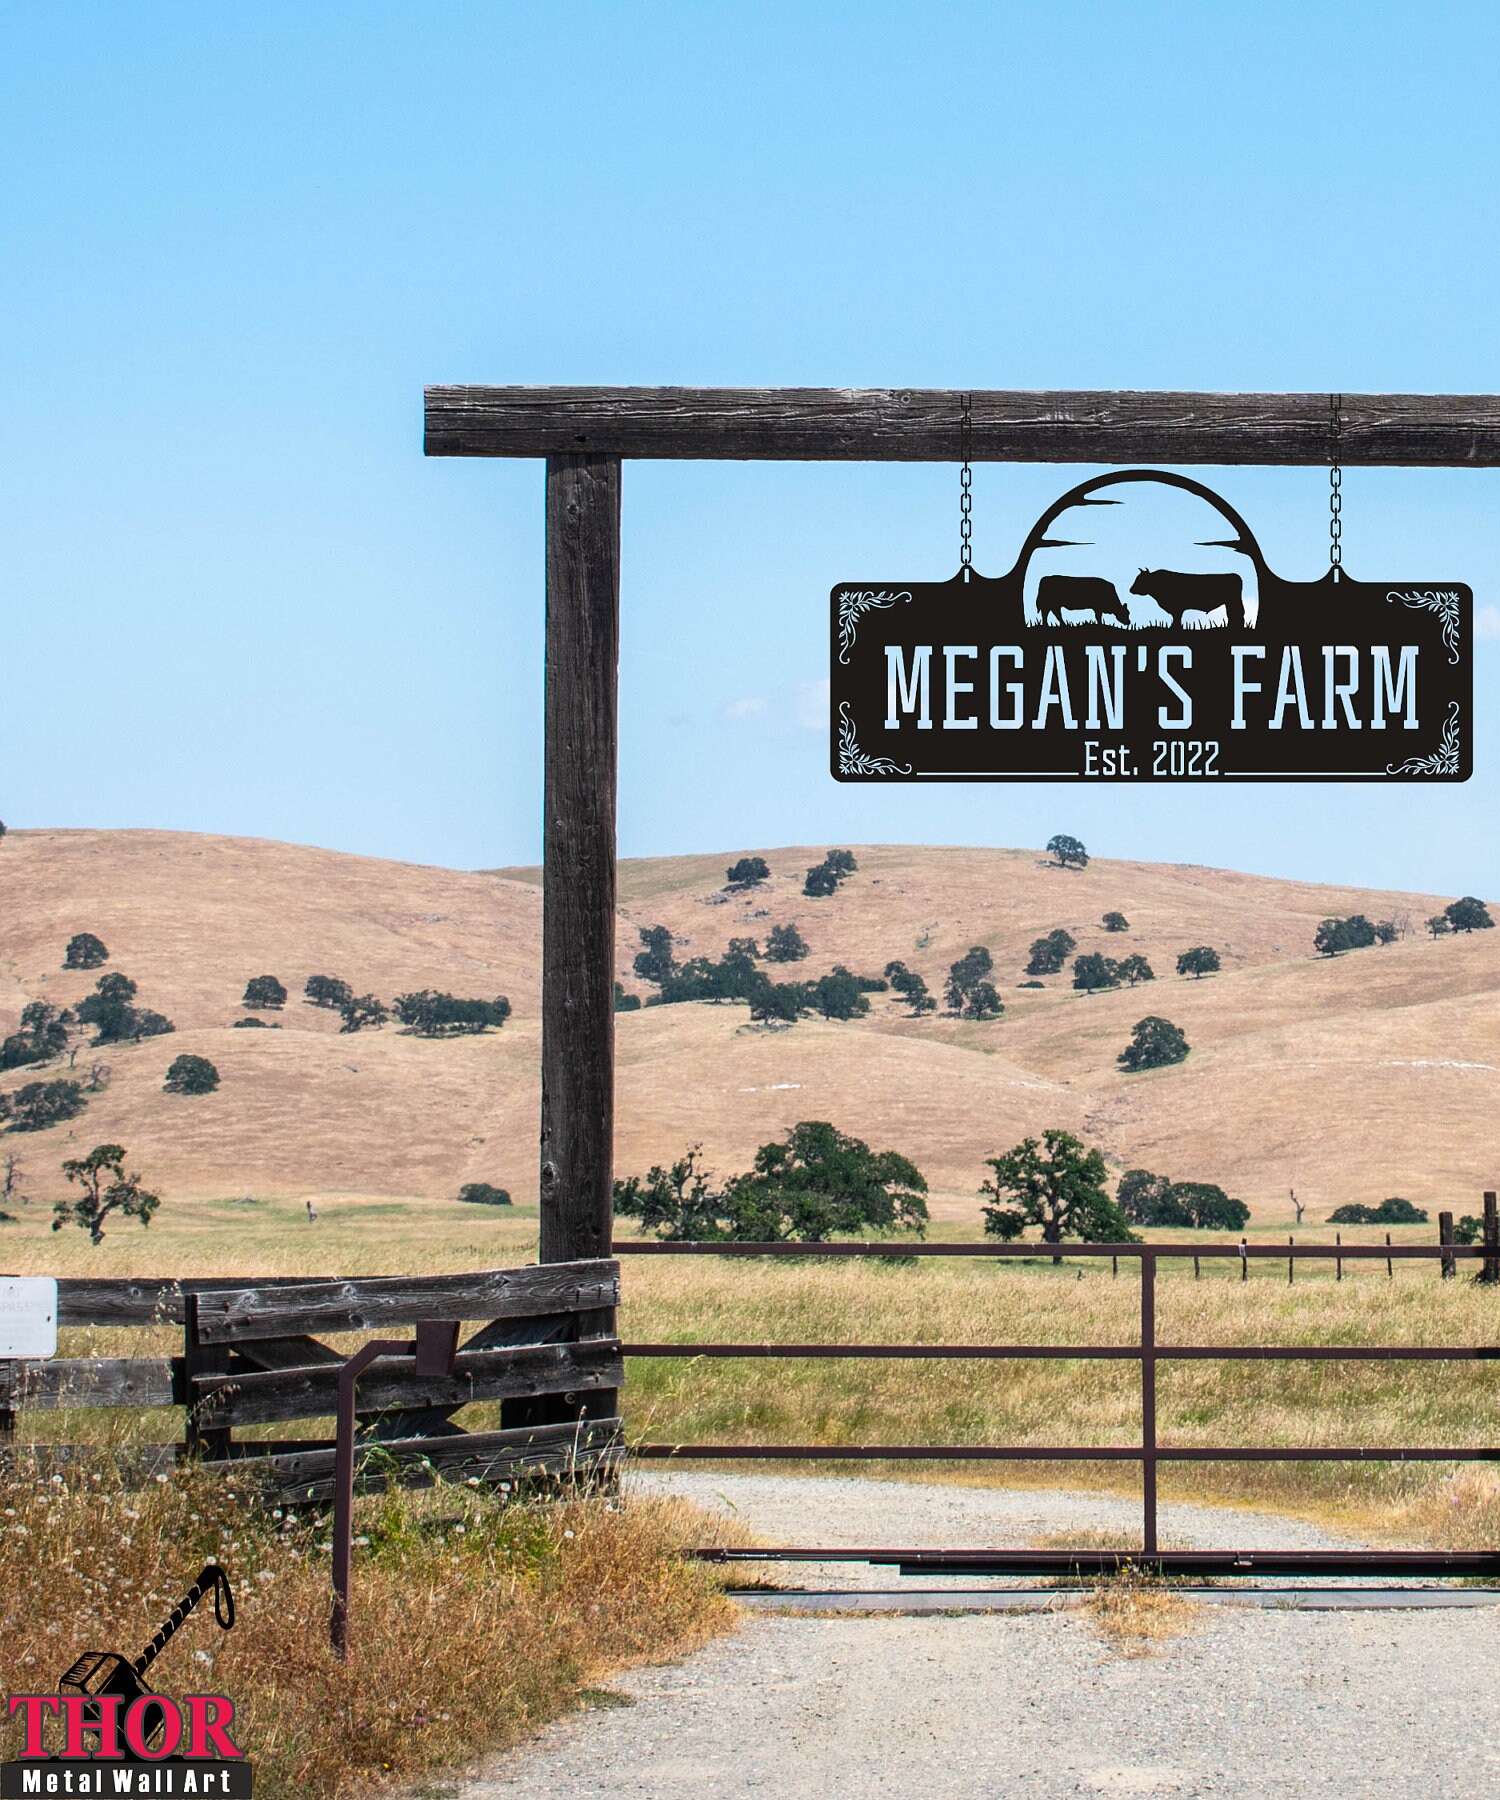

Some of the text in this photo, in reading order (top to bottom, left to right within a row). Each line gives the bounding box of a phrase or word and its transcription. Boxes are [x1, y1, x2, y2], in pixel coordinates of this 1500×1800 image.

[884, 645, 1419, 730] MEGAN'S FARM
[1084, 740, 1219, 776] Est. 2022
